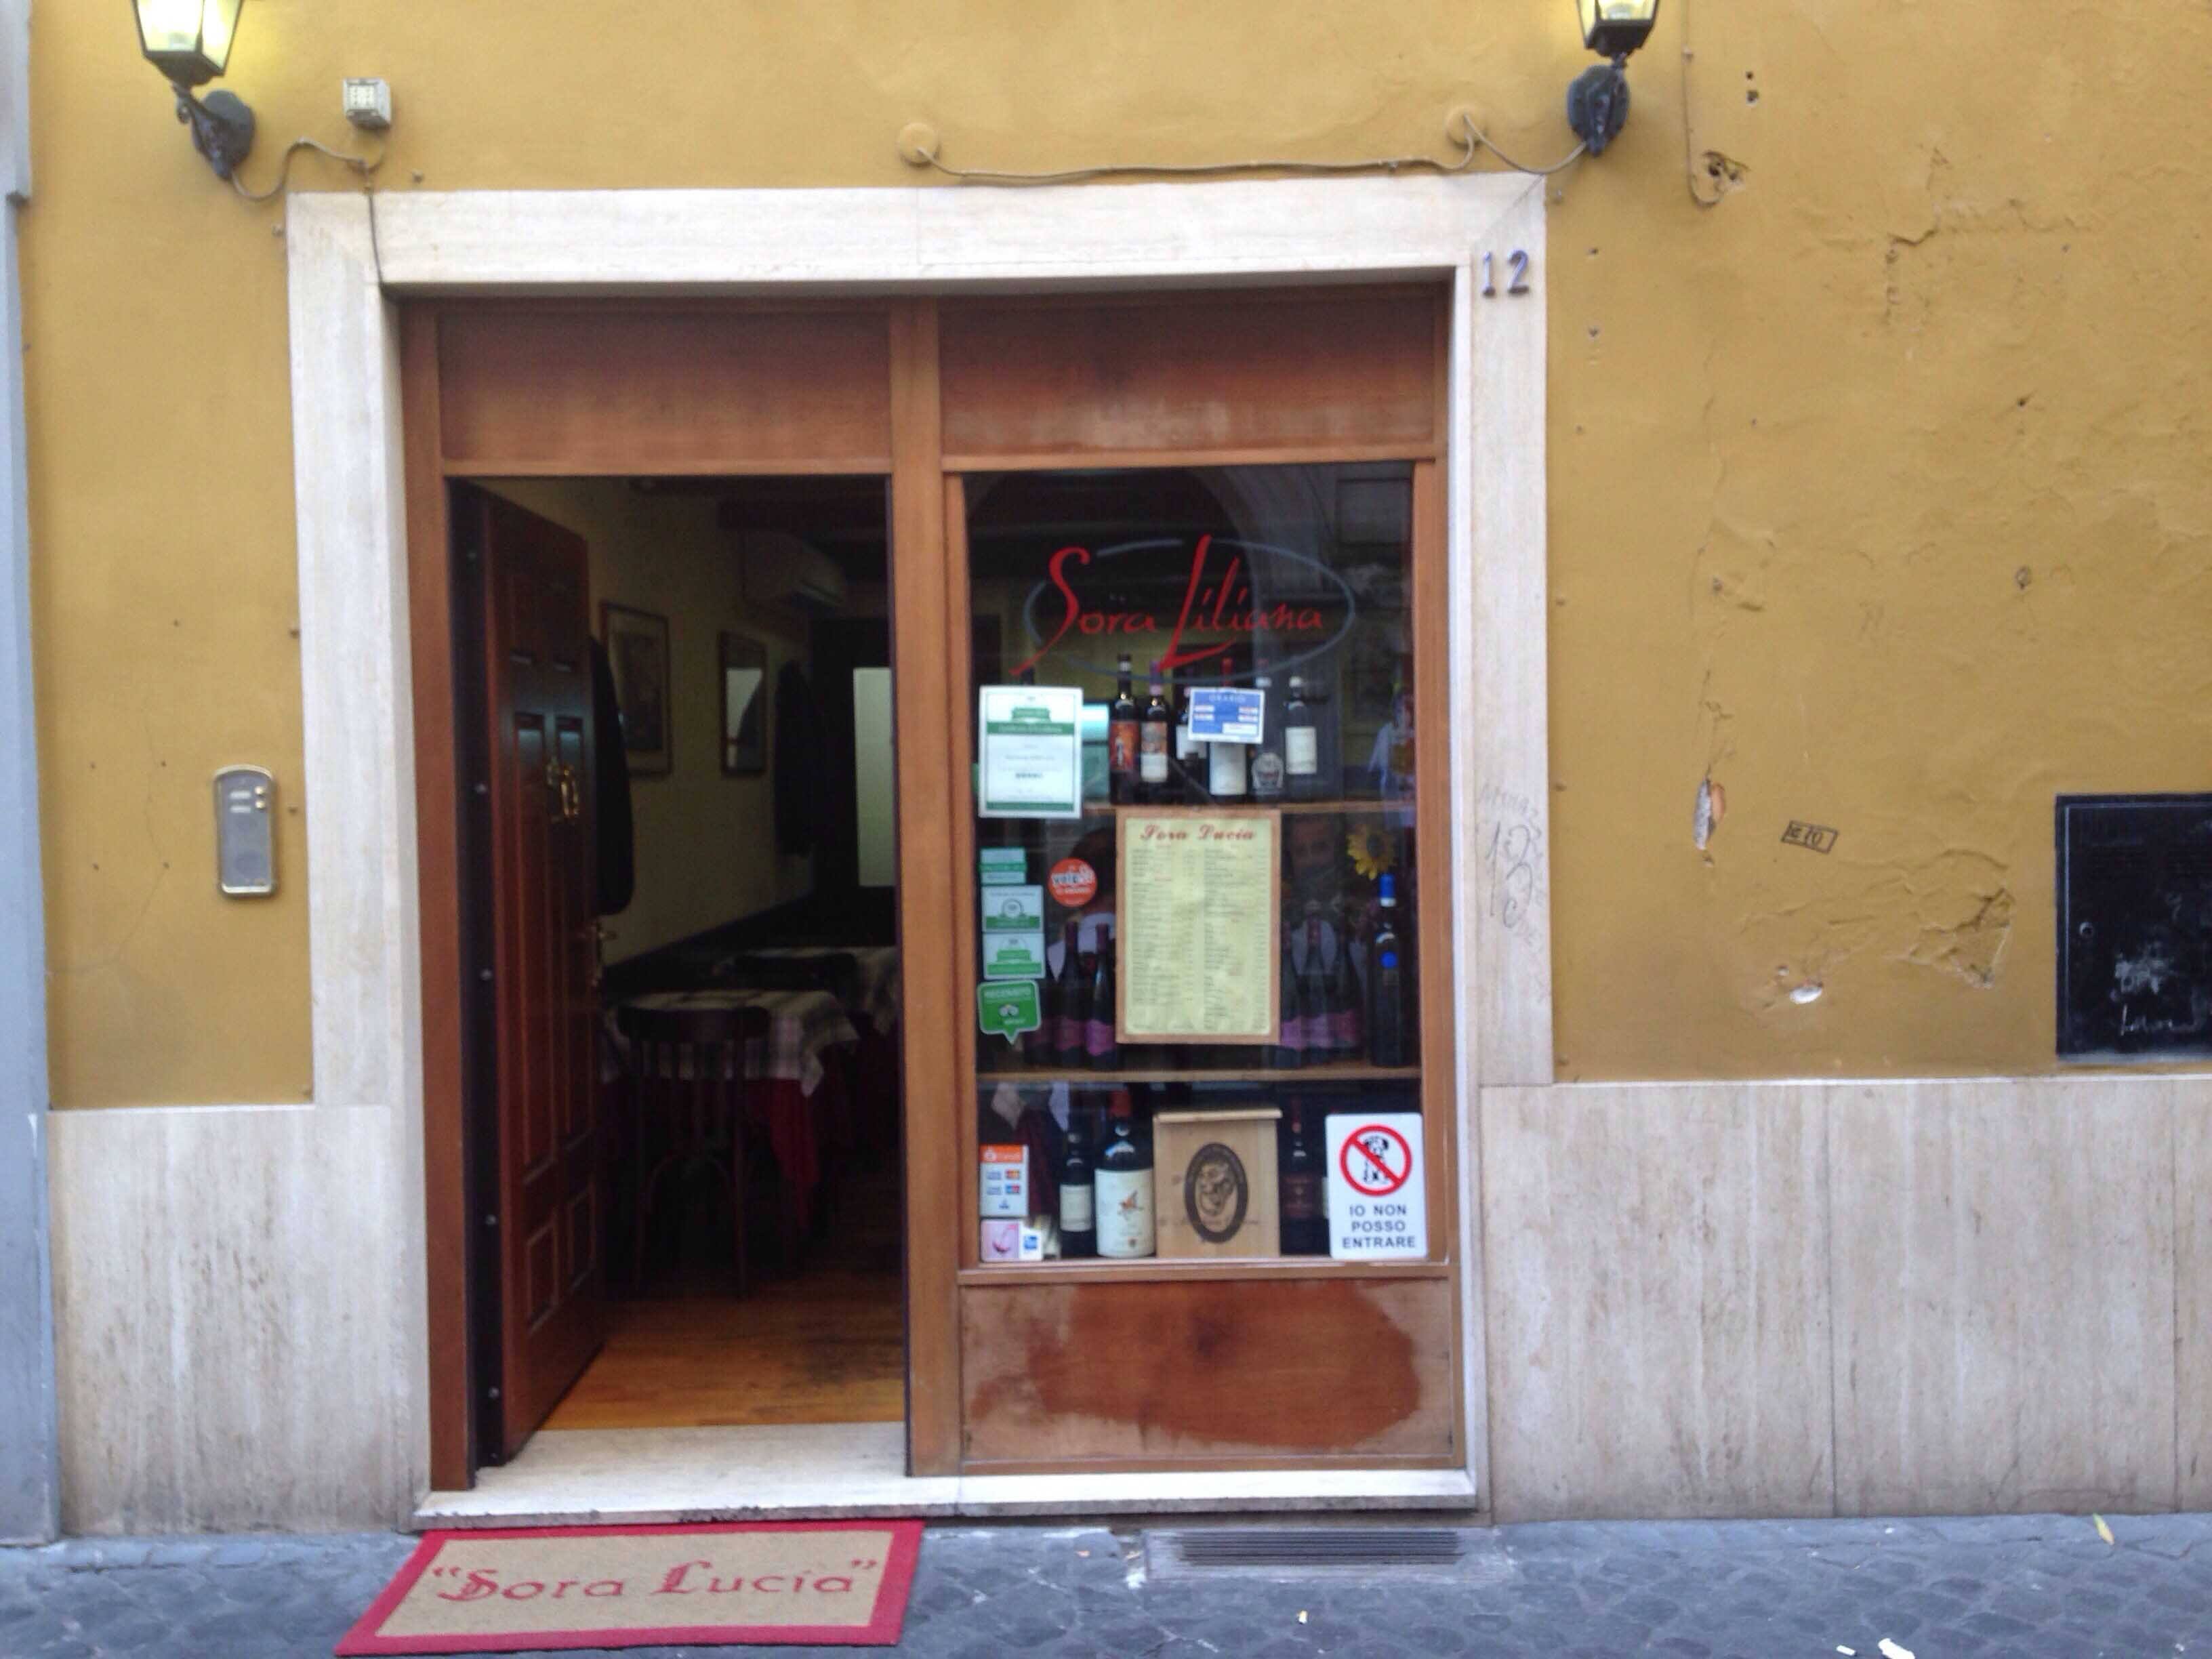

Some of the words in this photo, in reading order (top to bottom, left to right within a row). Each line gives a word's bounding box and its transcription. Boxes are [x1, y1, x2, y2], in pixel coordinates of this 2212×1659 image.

[1482, 249, 1530, 299] 12
[1008, 546, 1158, 676] Sora
[1158, 534, 1324, 672] Liliana
[1139, 823, 1188, 840] Sora
[1197, 823, 1254, 840] Lucia
[1349, 1204, 1366, 1216] IO
[1373, 1204, 1407, 1216] NON
[1351, 1220, 1406, 1233] POSSO
[1342, 1235, 1416, 1249] ENTRARE
